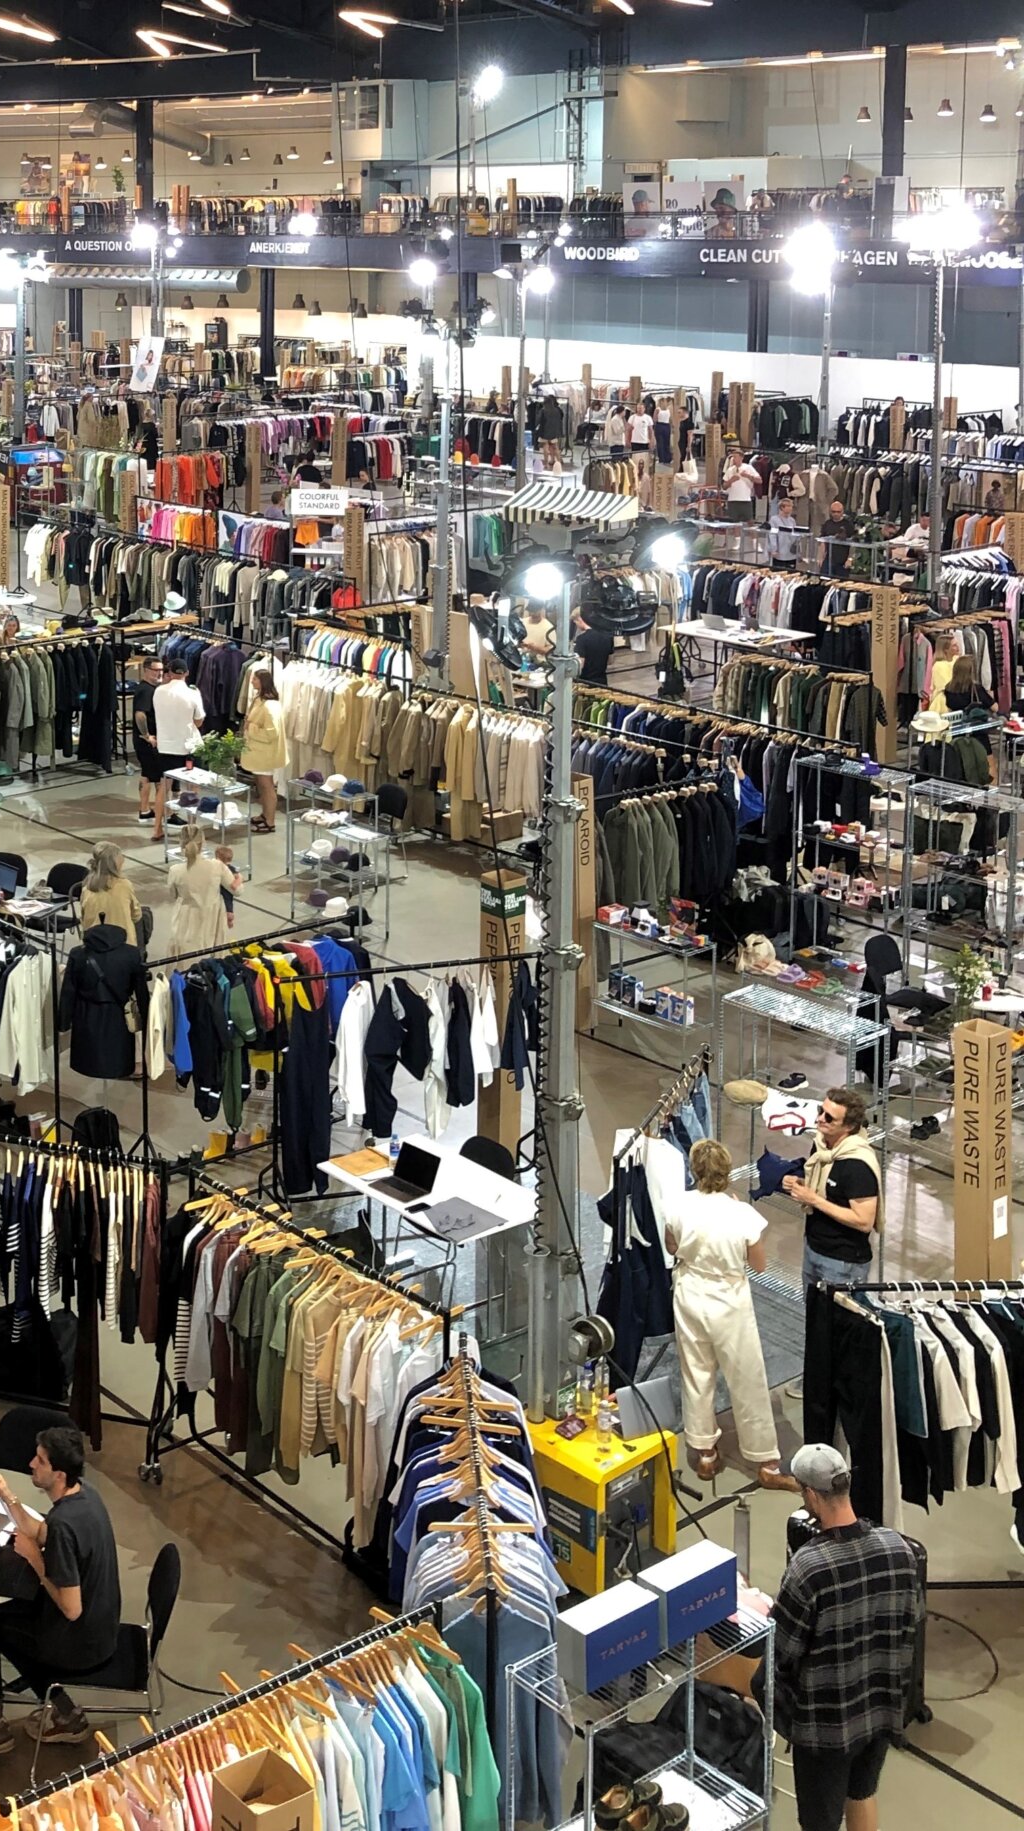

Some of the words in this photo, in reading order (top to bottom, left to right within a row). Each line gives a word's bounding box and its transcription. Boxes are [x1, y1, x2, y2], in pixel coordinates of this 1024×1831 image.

[65, 241, 72, 250] A
[74, 240, 122, 251] QUESTION
[699, 248, 747, 263] CLEAN
[751, 249, 780, 264] CUT
[299, 493, 339, 501] COLORFUL
[299, 502, 340, 510] STANDARD
[876, 593, 884, 621] STAN
[889, 593, 897, 621] STAN
[876, 624, 884, 645] RAY
[889, 624, 897, 645] RAY
[579, 786, 590, 867] POLAROID
[964, 1039, 980, 1104] PURE
[995, 1042, 1007, 1105] PURE
[964, 1109, 980, 1189] WASTE
[995, 1109, 1007, 1190] WASTE
[556, 1543, 570, 1561] 15
[680, 1587, 727, 1616] TARVAS
[600, 1629, 648, 1660] TARVAS
